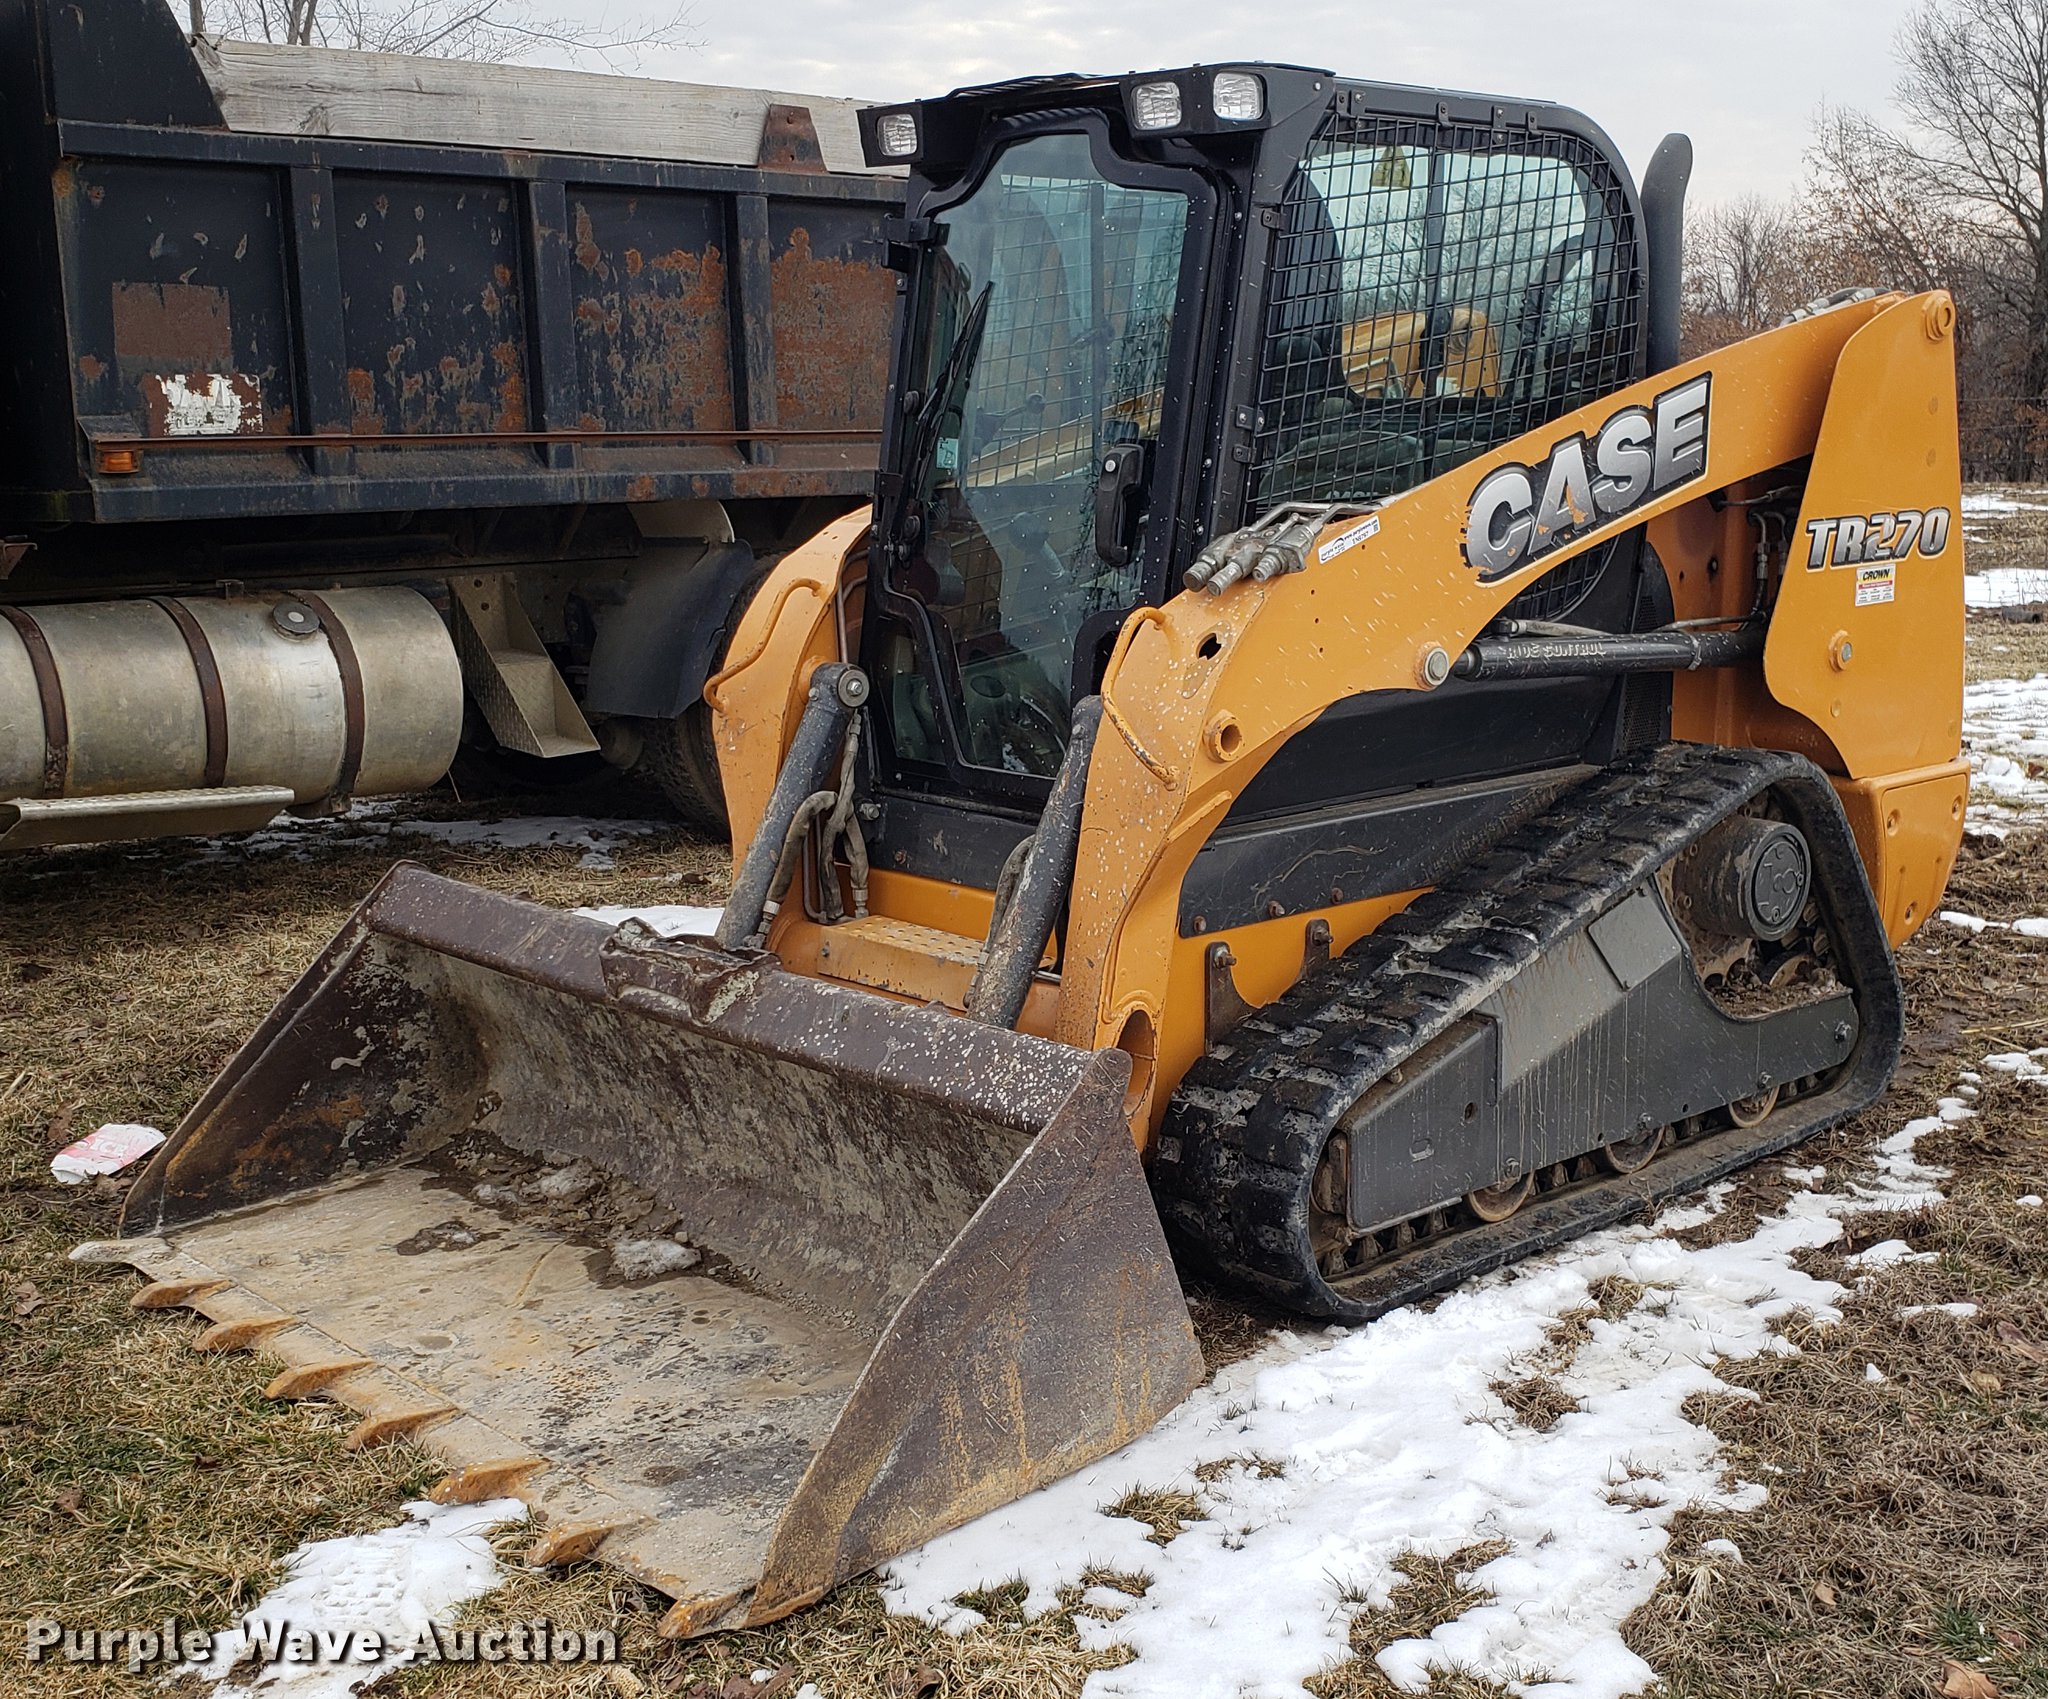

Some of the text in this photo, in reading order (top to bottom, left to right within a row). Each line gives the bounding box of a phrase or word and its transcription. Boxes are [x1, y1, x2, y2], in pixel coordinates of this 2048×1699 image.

[1465, 375, 1711, 577] CASE
[1806, 507, 1951, 570] TR270
[1863, 568, 1890, 581] CROWN
